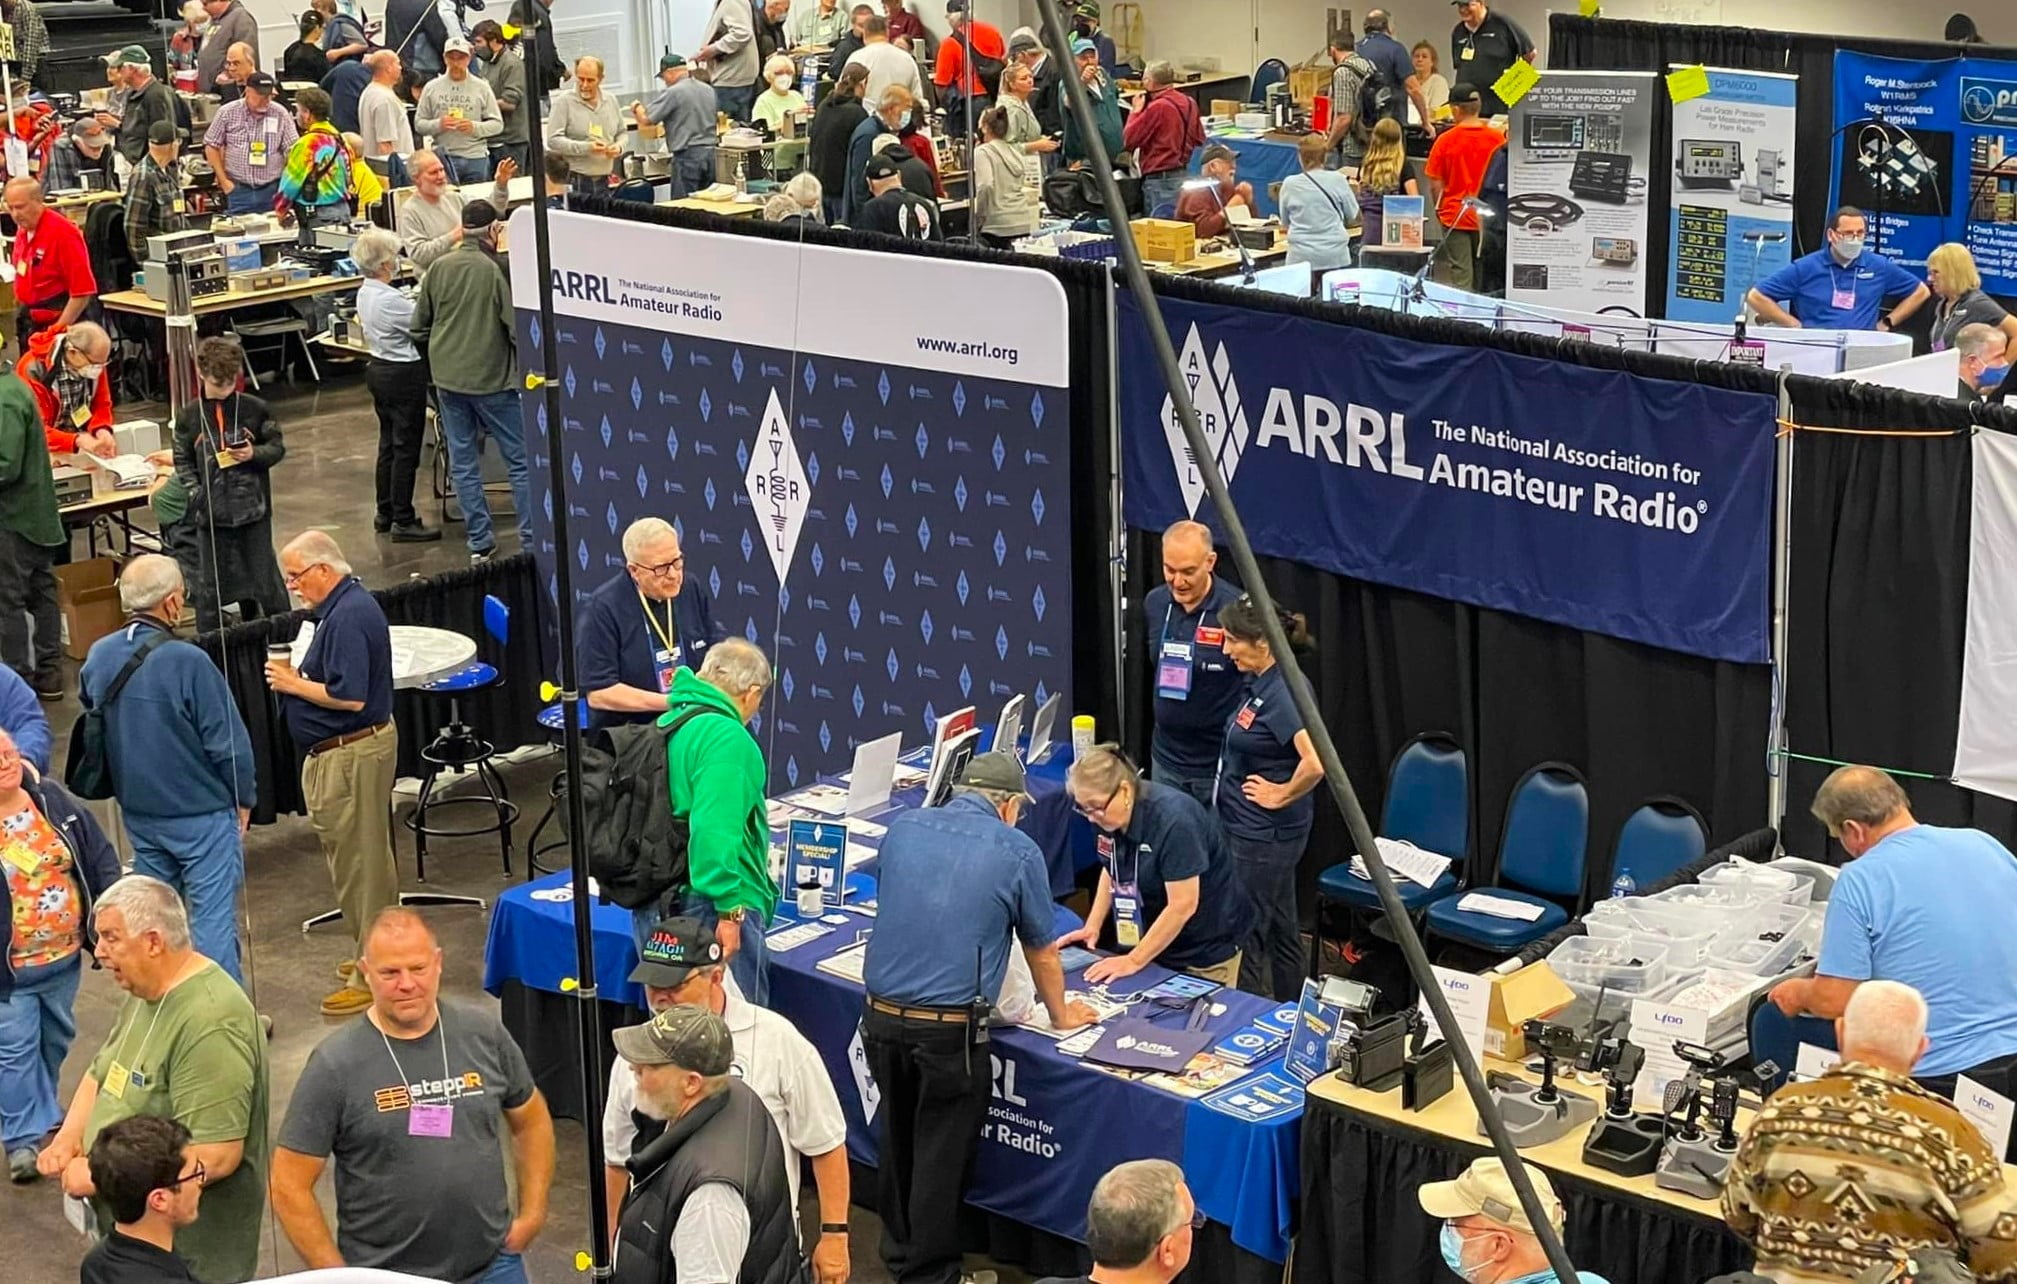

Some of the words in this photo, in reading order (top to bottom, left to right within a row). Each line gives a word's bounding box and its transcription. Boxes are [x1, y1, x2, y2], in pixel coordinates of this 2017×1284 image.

[1544, 87, 1562, 95] YOUR
[1564, 87, 1615, 95] TRANSMISSION
[551, 268, 617, 305] ARRL
[618, 278, 632, 289] The
[633, 280, 665, 294] National
[666, 286, 708, 301] Association
[710, 292, 721, 302] for
[620, 293, 679, 317] Amateur
[682, 303, 722, 322] Radio
[916, 337, 1019, 365] www.arrl.org
[1188, 352, 1198, 370] A
[770, 417, 781, 437] A
[1205, 414, 1216, 434] R
[1255, 387, 1424, 481] ARRL
[1431, 419, 1466, 443] The
[1471, 425, 1550, 459] National
[1553, 442, 1668, 480] Association
[1672, 462, 1701, 486] for
[757, 475, 766, 496] R
[789, 481, 799, 502] R
[1187, 467, 1197, 485] L
[1428, 453, 1584, 512] Amateur
[776, 534, 784, 552] L
[651, 931, 678, 945] JIM
[988, 1105, 1036, 1129] sociation
[1038, 1119, 1054, 1136] for
